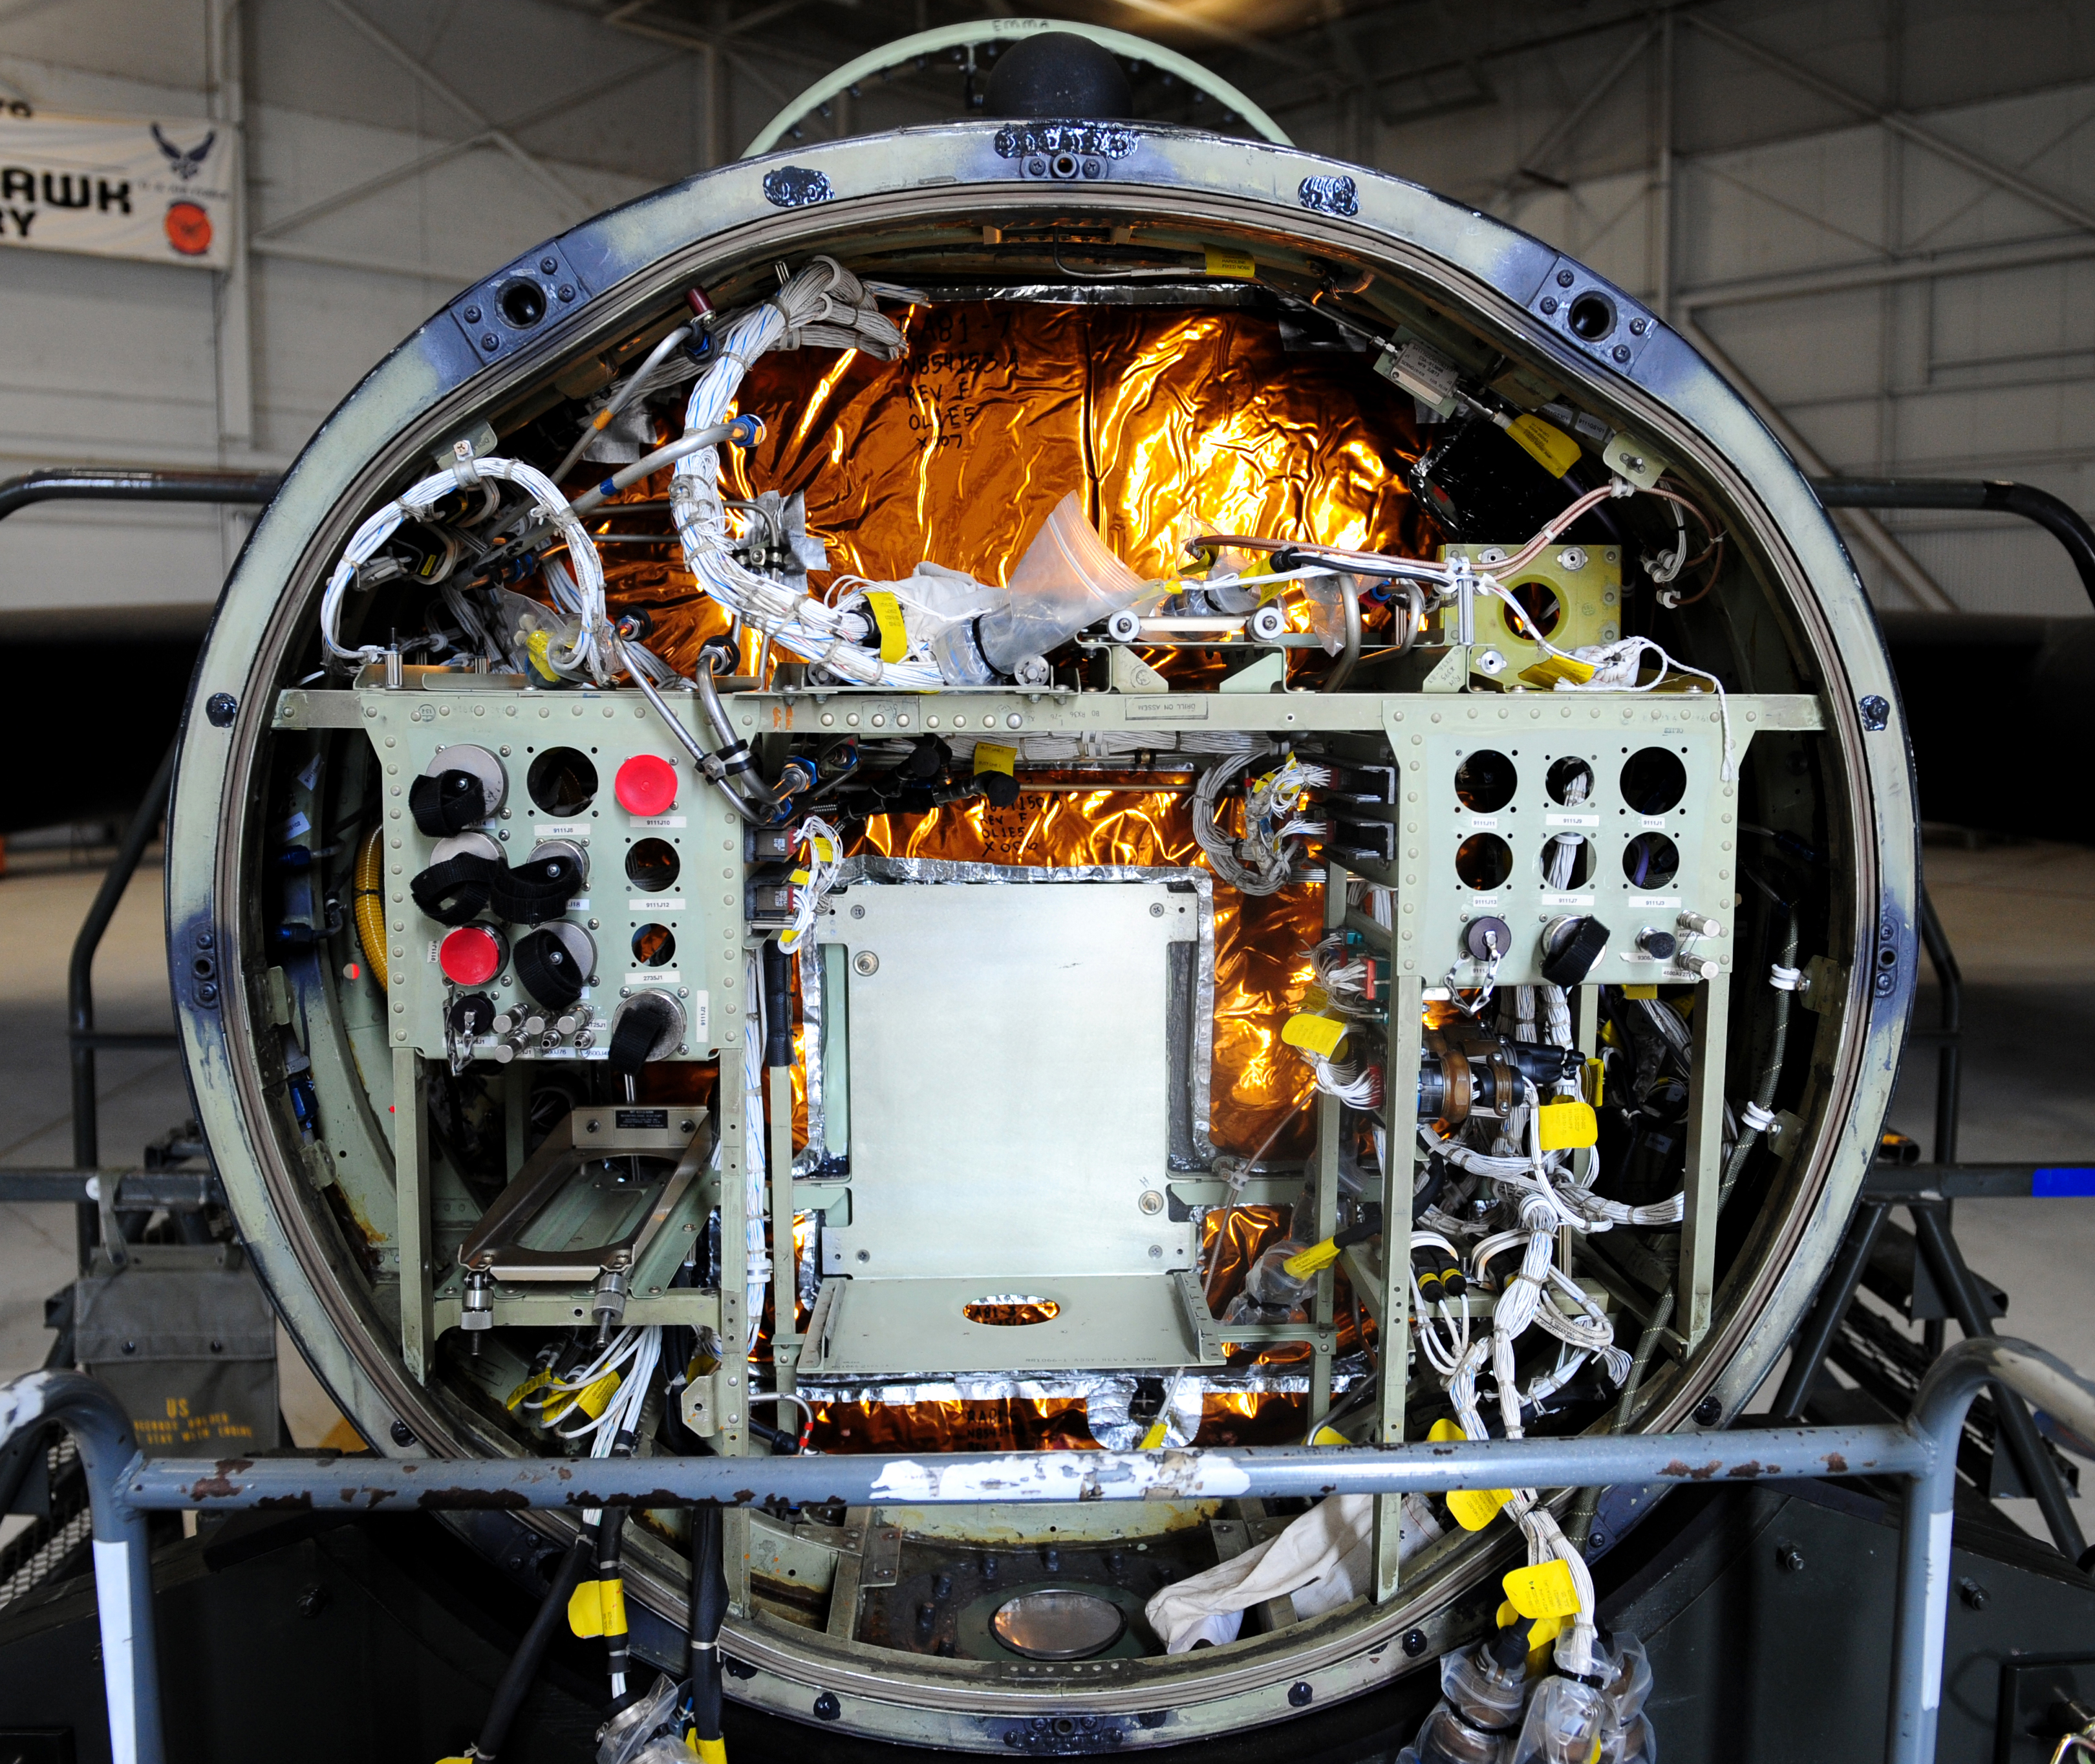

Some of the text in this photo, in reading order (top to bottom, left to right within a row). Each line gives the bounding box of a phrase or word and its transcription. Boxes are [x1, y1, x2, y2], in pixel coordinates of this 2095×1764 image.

[906, 383, 942, 409] REV
[1018, 813, 1027, 823] F
[166, 1397, 189, 1419] US
